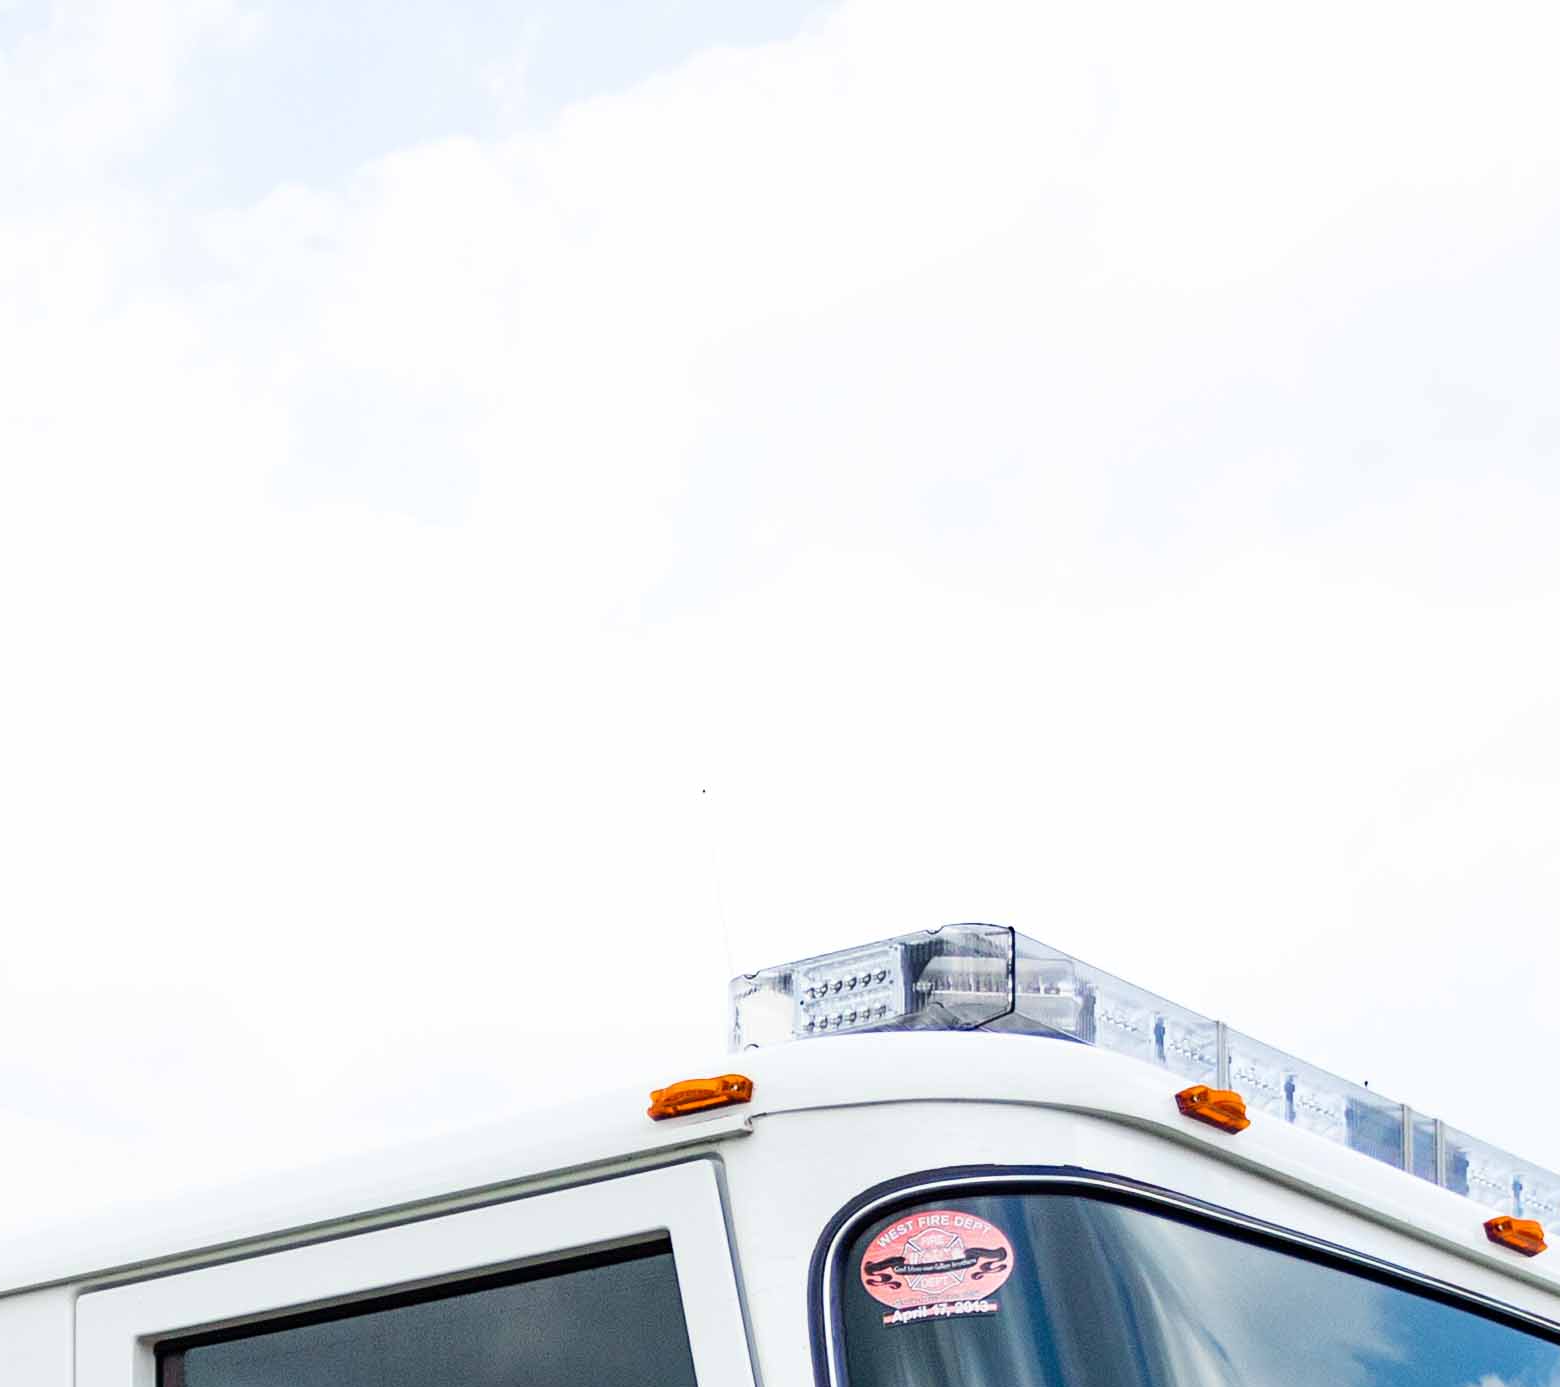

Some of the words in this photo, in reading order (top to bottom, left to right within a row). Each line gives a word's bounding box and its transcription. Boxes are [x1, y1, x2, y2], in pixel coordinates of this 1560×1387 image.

[877, 1220, 914, 1247] WEST
[918, 1215, 950, 1228] FIRE
[953, 1216, 993, 1234] DEPT
[892, 1305, 927, 1323] April
